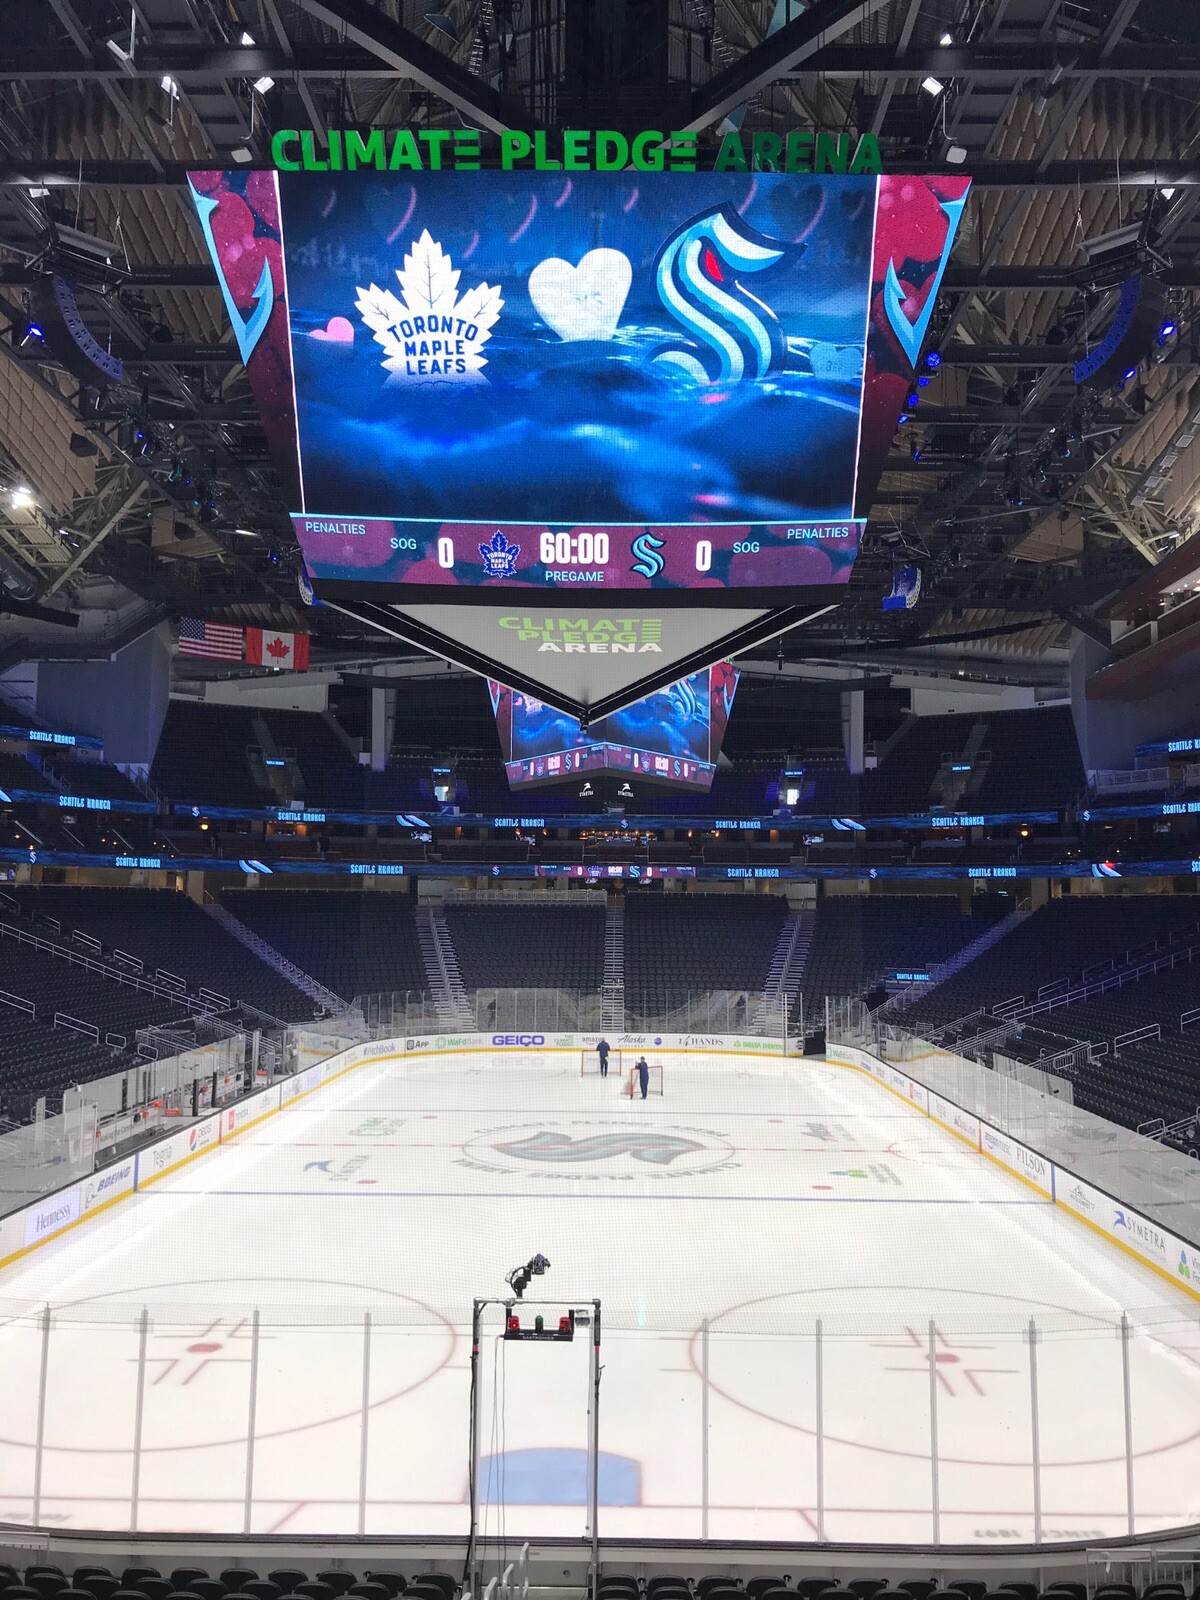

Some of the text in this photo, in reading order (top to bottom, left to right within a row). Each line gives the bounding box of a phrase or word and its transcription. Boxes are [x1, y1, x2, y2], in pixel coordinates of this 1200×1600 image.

[271, 130, 883, 172] CLIMATE PLEDGE ARENA
[388, 315, 478, 344] TORONTO
[403, 340, 467, 357] MAPLE
[405, 357, 468, 377] LEAFS
[305, 521, 366, 536] PENALTIES
[787, 527, 849, 540] PENALTIES
[390, 538, 417, 550] SOG
[540, 532, 610, 565] 60:00
[733, 541, 760, 553] SOG
[438, 537, 454, 569] 0
[695, 540, 711, 572] 0
[545, 571, 605, 582] PREGAME
[498, 616, 661, 630] CLIMATE
[518, 630, 661, 643] PLEDGE
[537, 642, 663, 653] ARENA
[59, 796, 85, 809] SEATTLE
[494, 817, 519, 827] SEATTLE
[932, 817, 957, 826] SEATTLE
[350, 864, 376, 875] SEATTLE
[727, 869, 752, 878] SEATTLE
[492, 1035, 545, 1047] GEICO
[618, 1034, 646, 1043] Alaska
[691, 1037, 724, 1047] HANDS
[1017, 1147, 1046, 1175] FILSON
[97, 1166, 131, 1192] BOEING
[36, 1205, 71, 1233] Hennessy
[1127, 1217, 1166, 1252] SYMETRA
